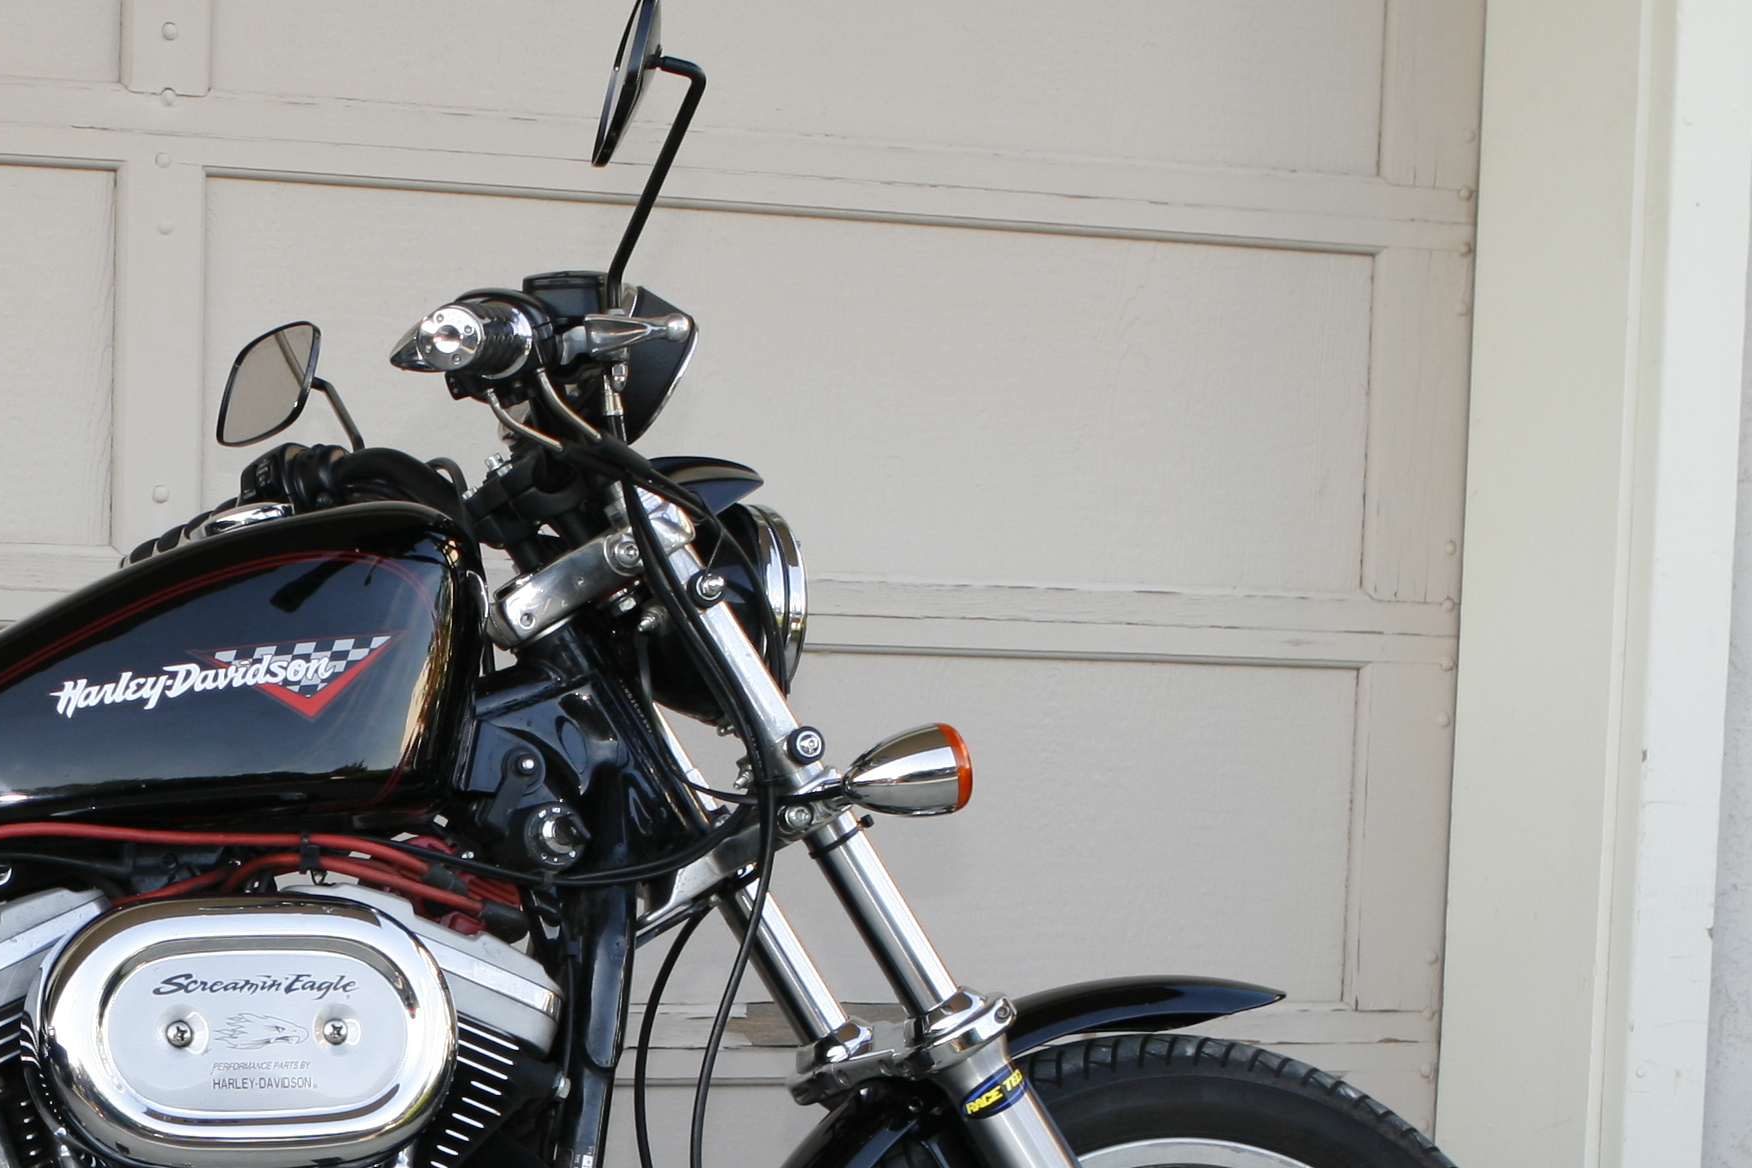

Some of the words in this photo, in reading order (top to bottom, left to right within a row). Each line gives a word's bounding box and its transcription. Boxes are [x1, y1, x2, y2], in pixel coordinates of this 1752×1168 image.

[49, 654, 334, 718] Harley-Davidson
[284, 973, 360, 1000] Eagle
[211, 1062, 272, 1072] PERFORMANCE
[273, 1061, 299, 1071] PARTS
[300, 1061, 312, 1071] BY
[212, 1077, 313, 1090] HARLEY-DAVIDSON
[965, 1085, 1004, 1115] RACE
